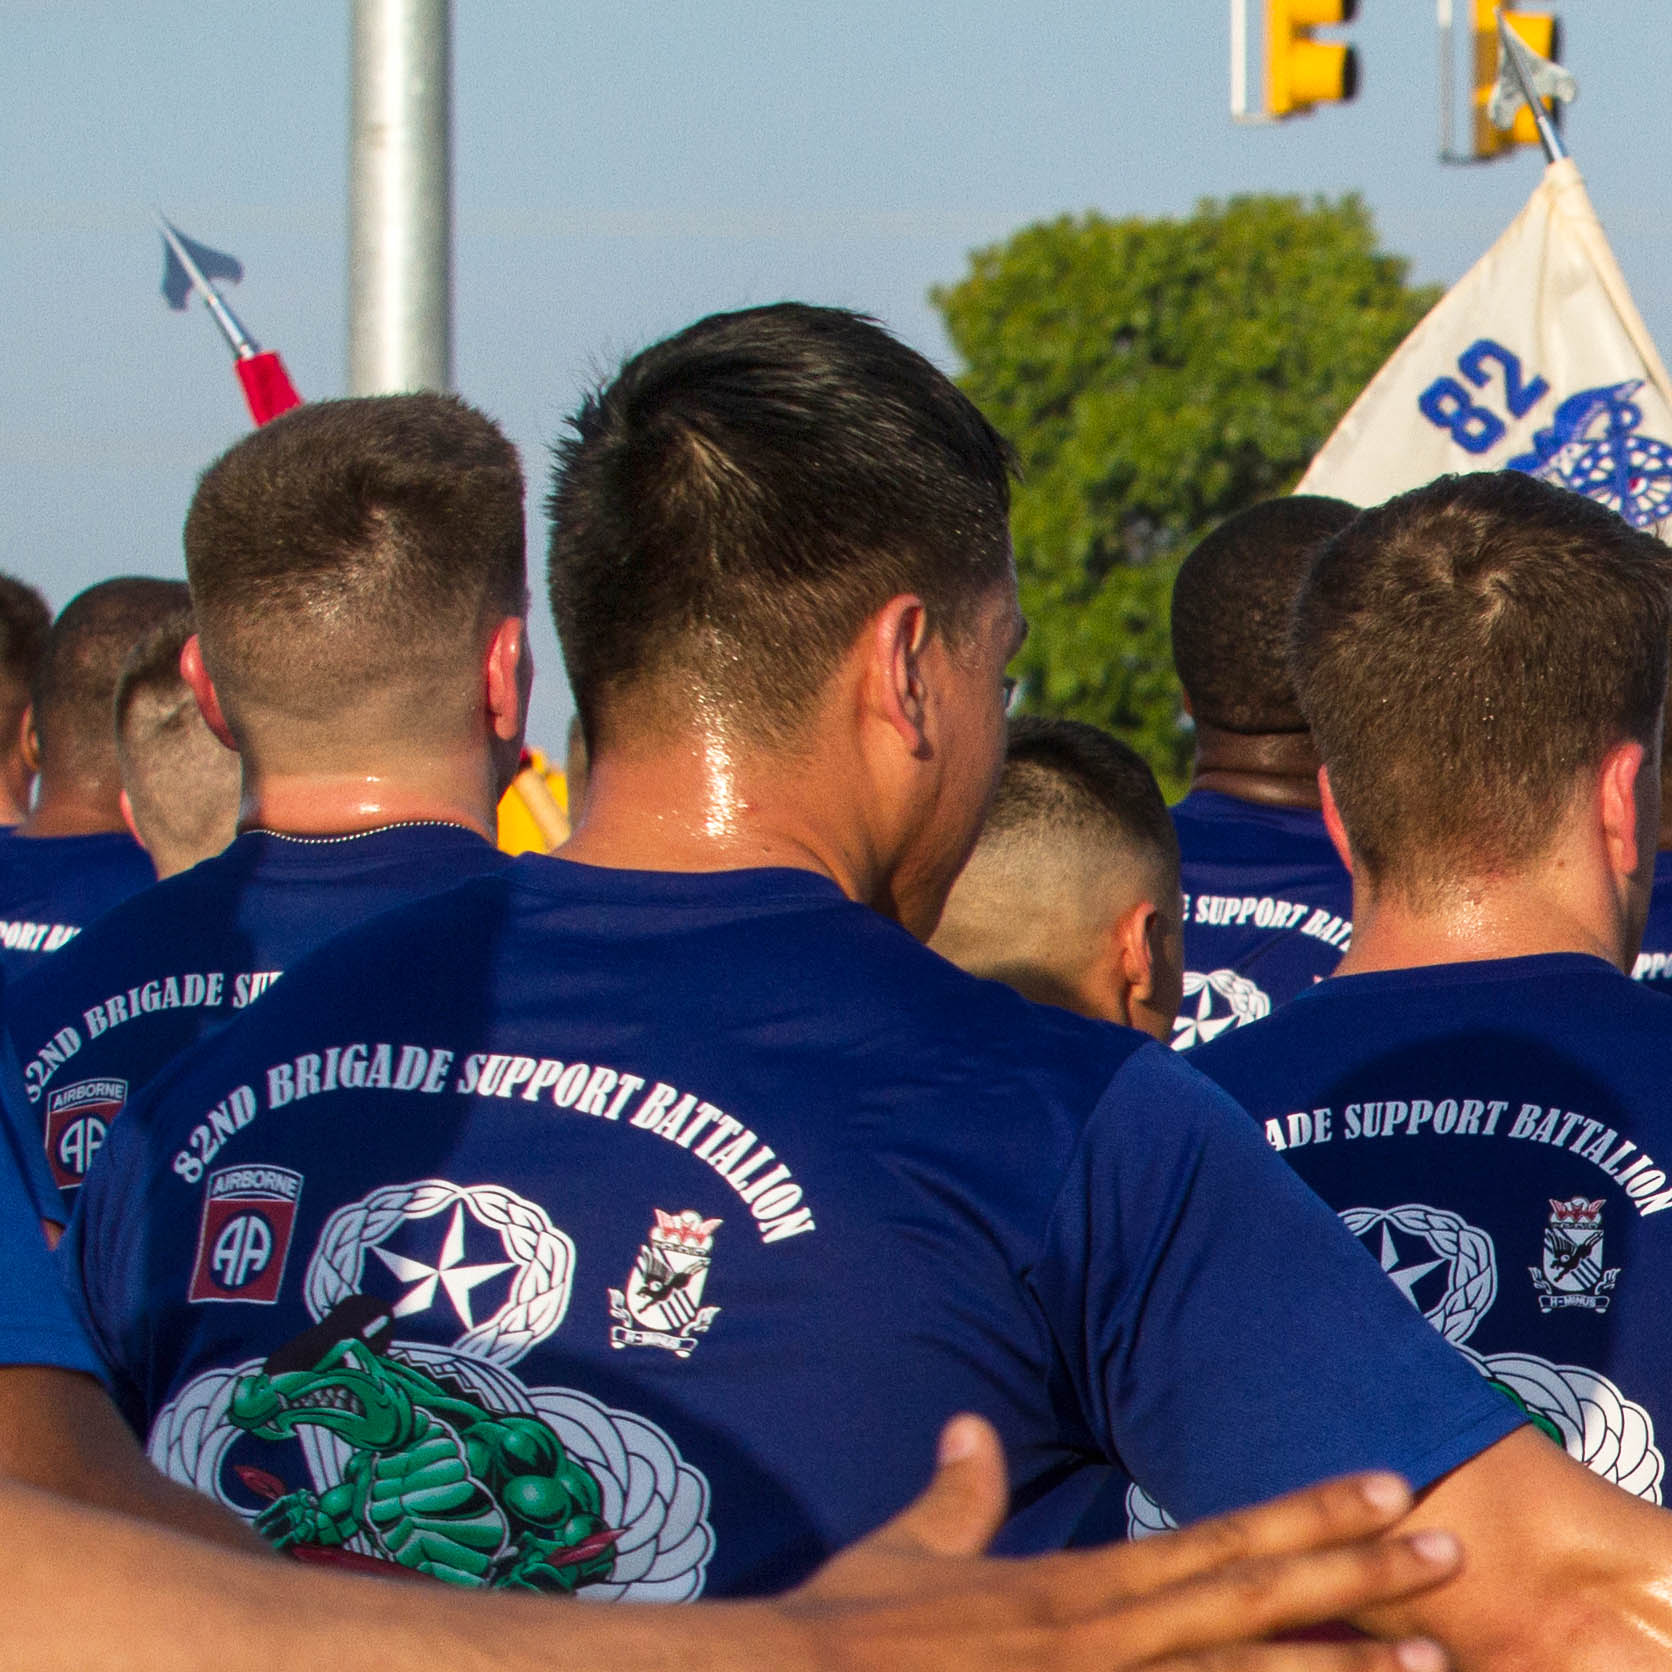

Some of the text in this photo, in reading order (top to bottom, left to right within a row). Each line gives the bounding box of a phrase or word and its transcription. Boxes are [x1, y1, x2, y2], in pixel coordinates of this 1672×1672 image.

[1418, 338, 1551, 455] 82
[1195, 895, 1308, 929] SUPPORT
[83, 972, 224, 1040] BRIGADE
[53, 1081, 125, 1111] AIRBORNE
[1345, 1099, 1509, 1141] SUPPORT
[173, 1043, 816, 1244] 82ND BRIGADE SUPPORT BATTALION
[212, 1170, 299, 1198] AIRBORNE
[212, 1215, 273, 1287] AA
